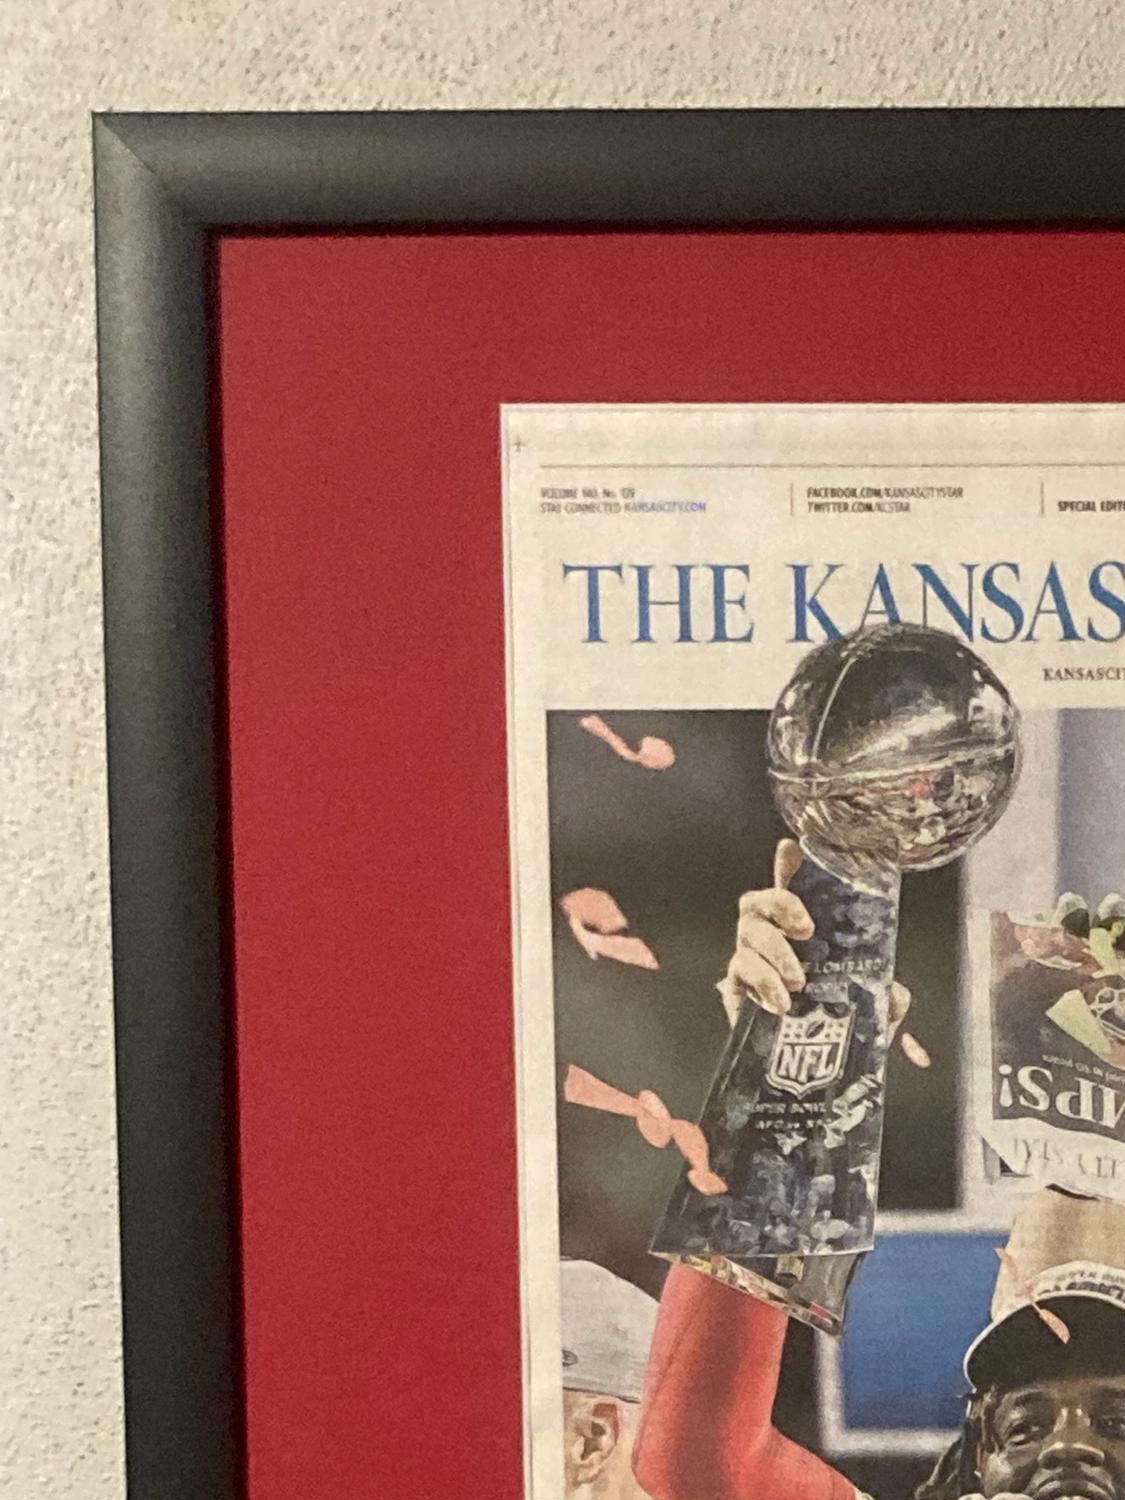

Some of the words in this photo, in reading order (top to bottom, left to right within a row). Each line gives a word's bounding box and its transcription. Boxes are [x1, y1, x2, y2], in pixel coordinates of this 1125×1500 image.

[1058, 500, 1096, 512] SPECIAL
[563, 562, 754, 644] THE
[776, 1044, 834, 1084] NFL
